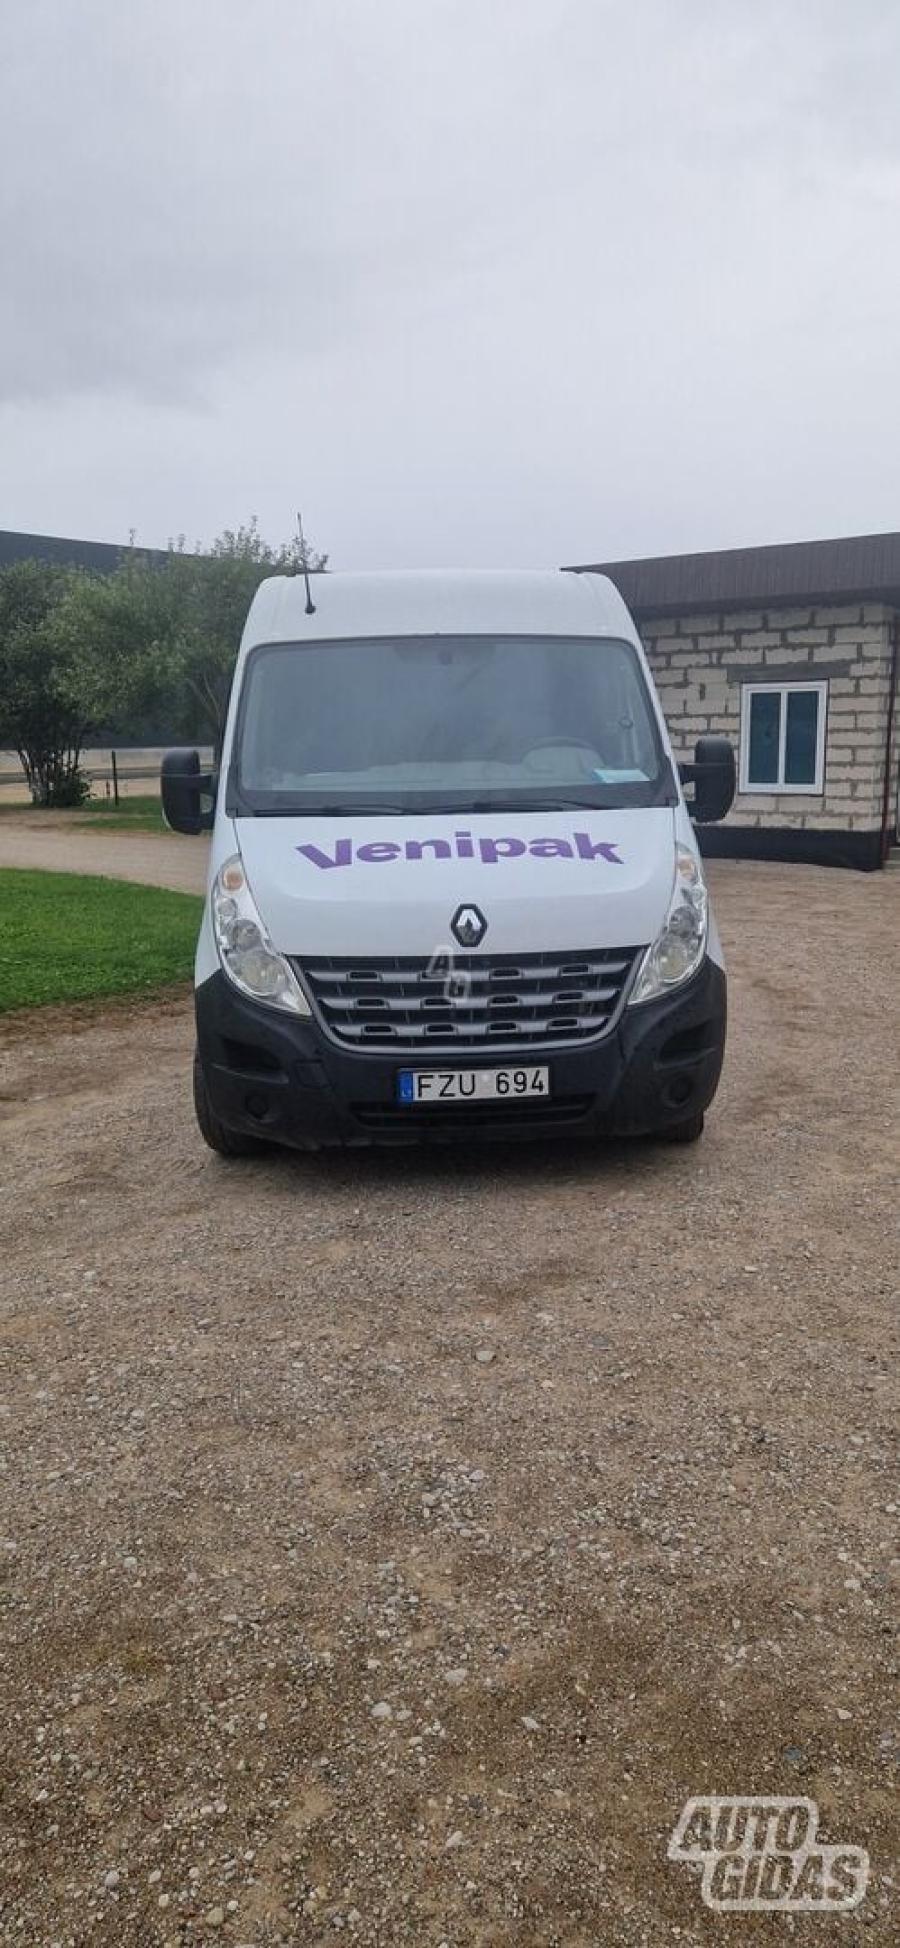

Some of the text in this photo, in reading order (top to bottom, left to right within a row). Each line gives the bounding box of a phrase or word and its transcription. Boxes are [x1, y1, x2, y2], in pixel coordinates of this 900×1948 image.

[297, 831, 624, 869] Venipak
[417, 1069, 544, 1098] FZU 694
